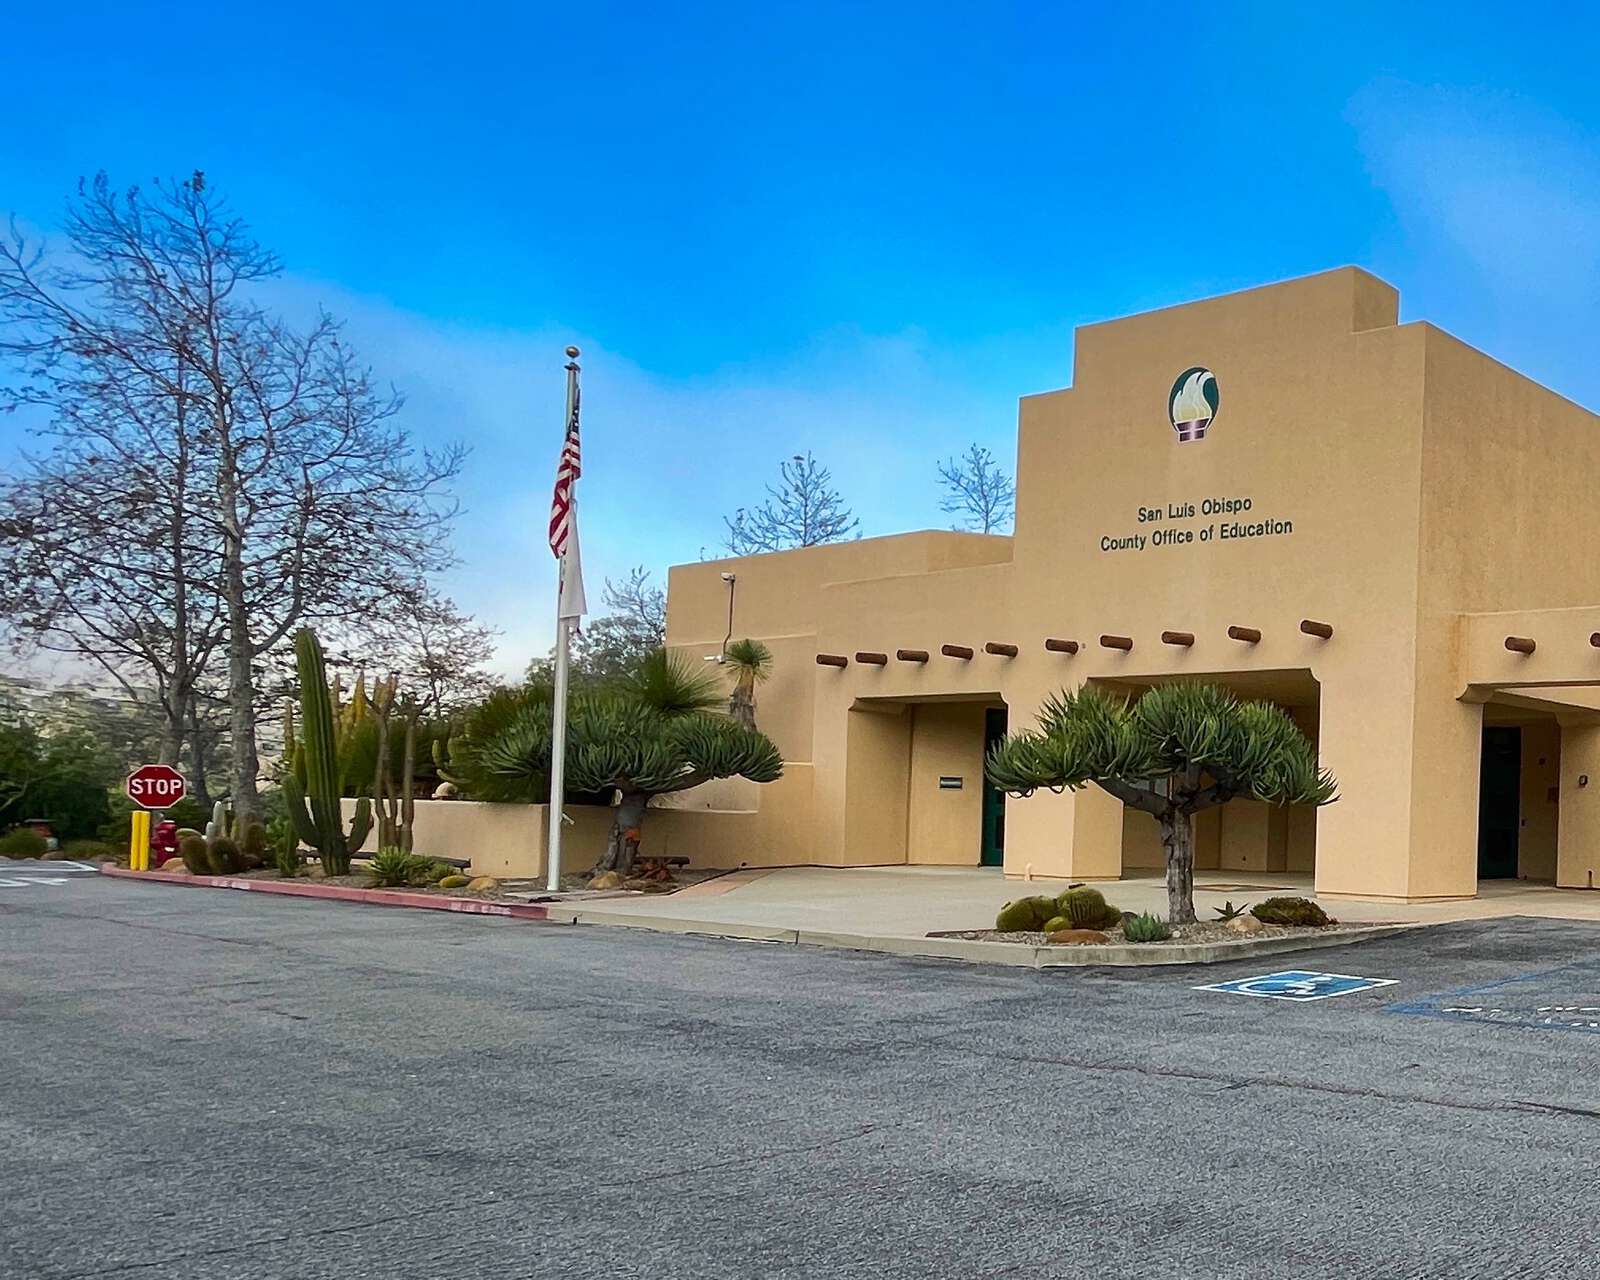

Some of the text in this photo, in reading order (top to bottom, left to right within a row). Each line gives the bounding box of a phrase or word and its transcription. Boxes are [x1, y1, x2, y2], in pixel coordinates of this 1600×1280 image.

[1137, 497, 1252, 522] San Luis Obispo
[1100, 518, 1293, 551] County Office of Education
[131, 778, 182, 795] STOP
